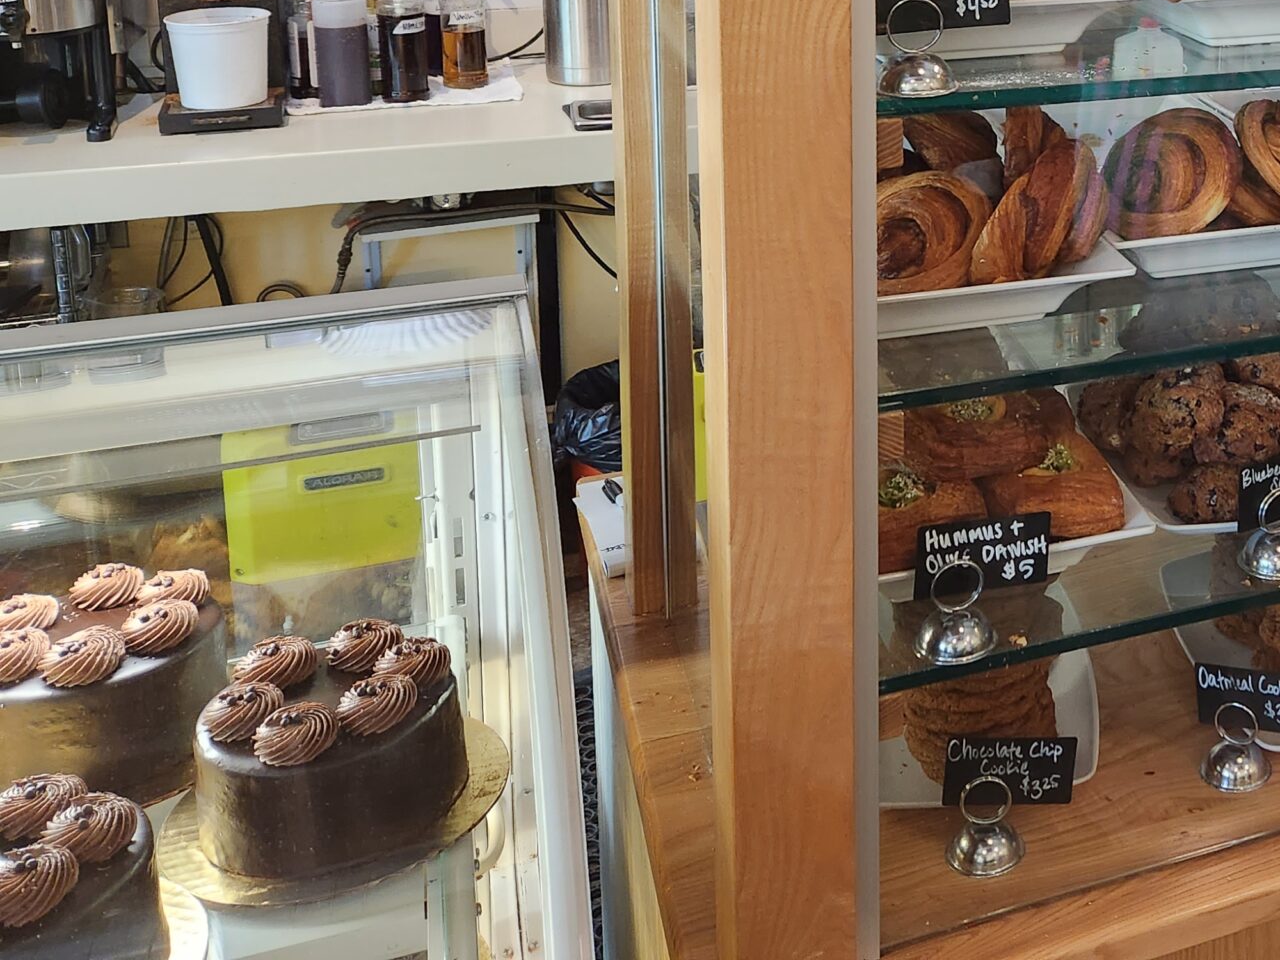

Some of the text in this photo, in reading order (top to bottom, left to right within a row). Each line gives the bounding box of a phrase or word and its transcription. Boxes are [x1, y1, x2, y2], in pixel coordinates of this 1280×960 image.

[1010, 520, 1024, 536] +
[982, 533, 1048, 563] DANISH
[1001, 558, 1035, 580] $5
[1198, 665, 1255, 693] Oatmeal
[947, 738, 1063, 763] Chocolate Chip
[980, 759, 1029, 775] Cookie
